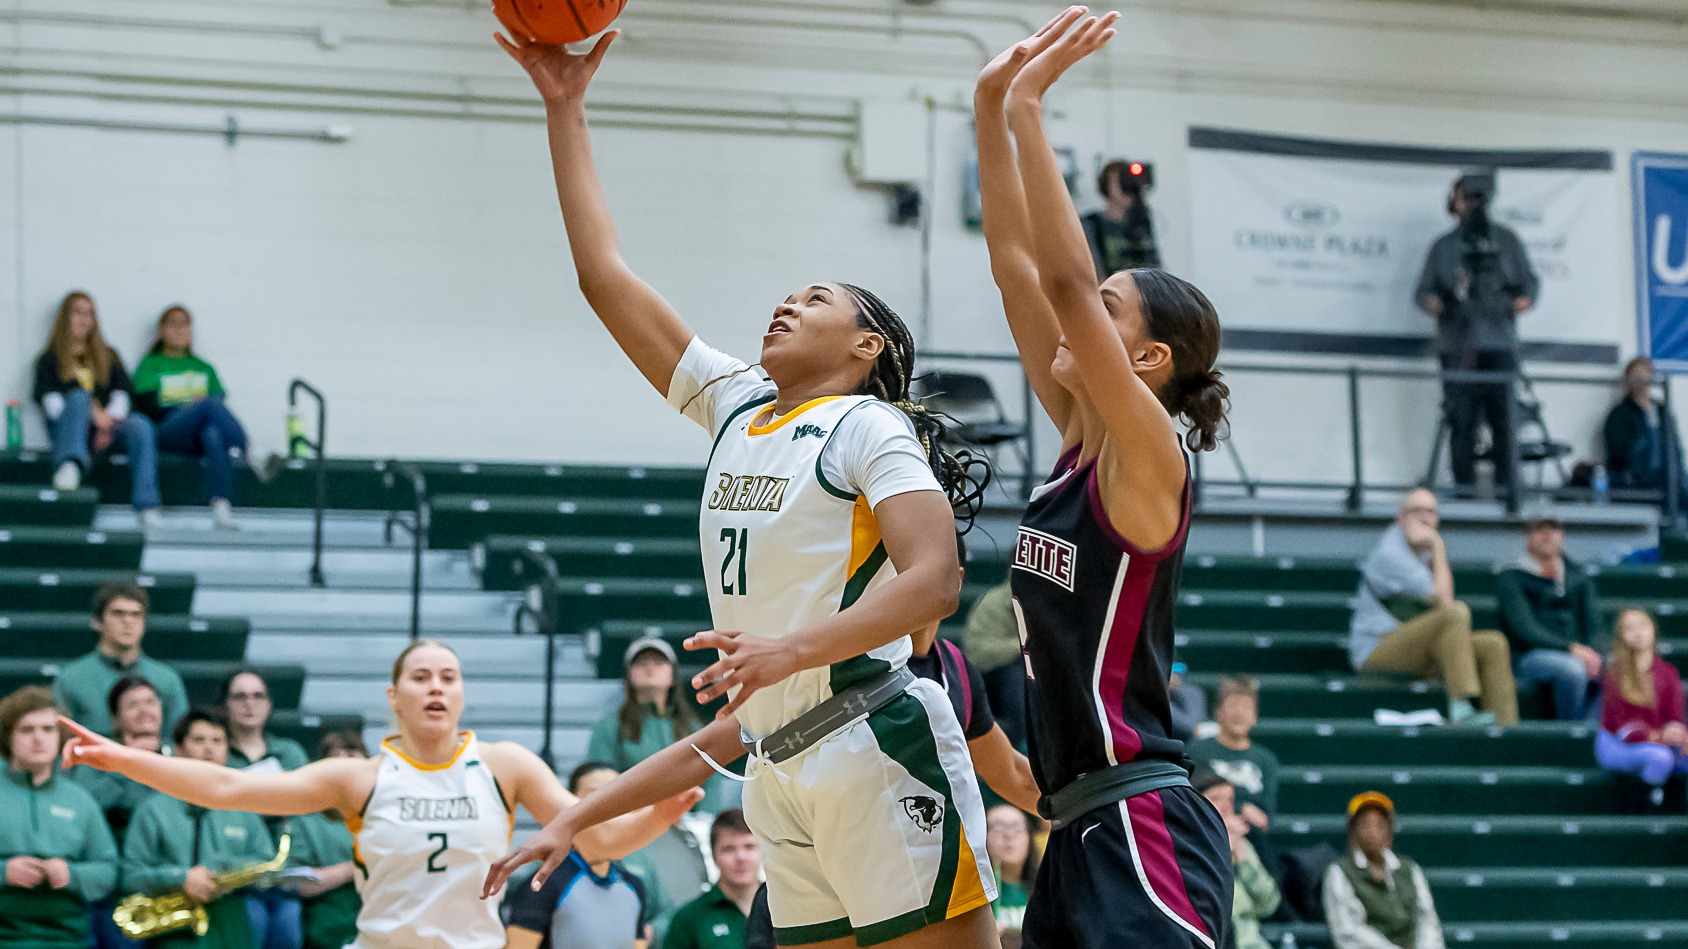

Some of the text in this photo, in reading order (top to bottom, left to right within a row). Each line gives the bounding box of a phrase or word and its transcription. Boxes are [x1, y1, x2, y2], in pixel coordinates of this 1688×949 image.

[792, 424, 827, 441] MAAC
[708, 472, 791, 512] SIENA
[720, 528, 748, 596] 21
[1013, 531, 1073, 586] ETTE
[399, 796, 479, 821] SIENA
[427, 832, 448, 873] 2
